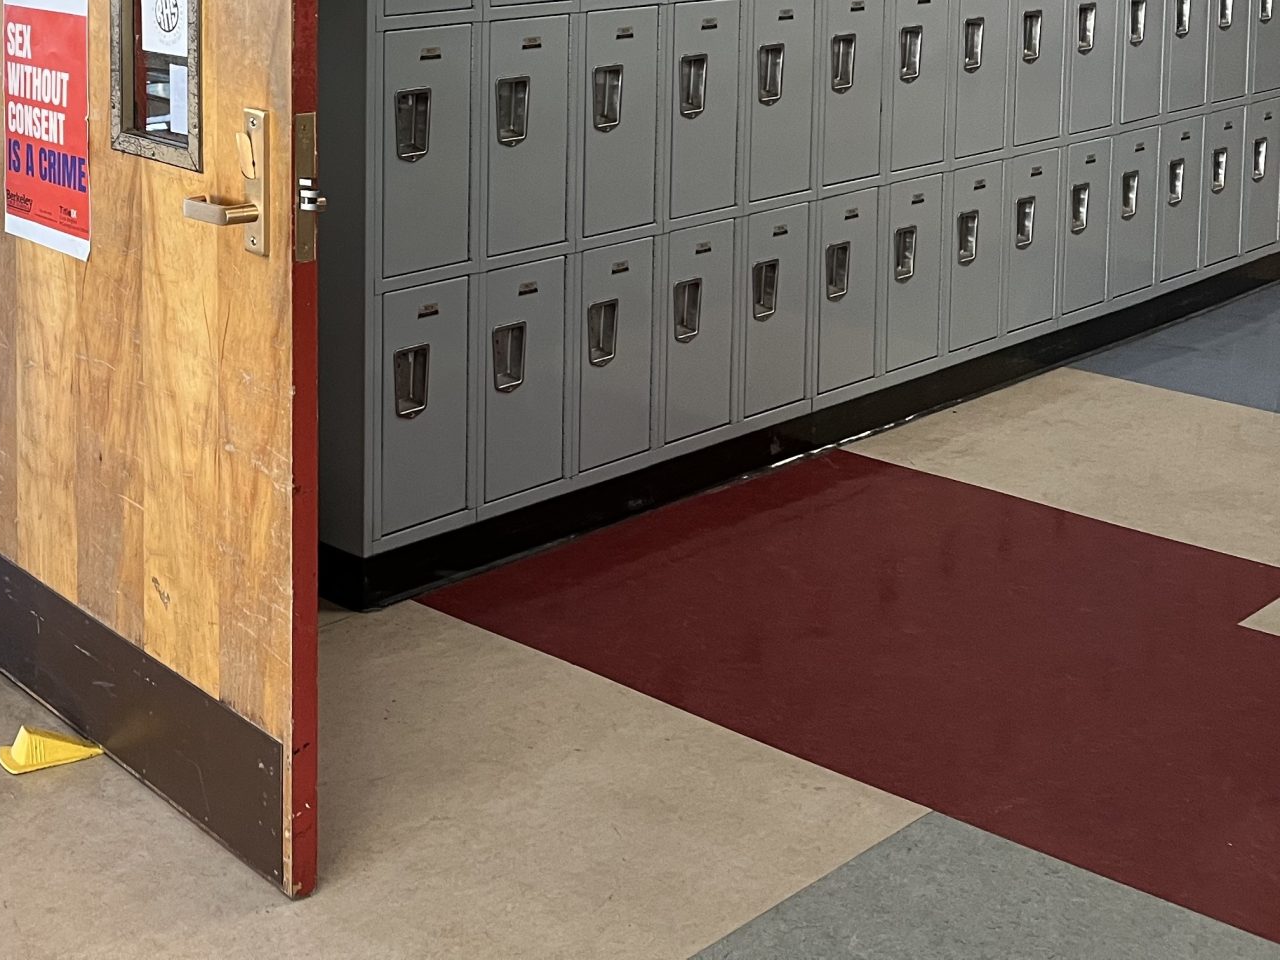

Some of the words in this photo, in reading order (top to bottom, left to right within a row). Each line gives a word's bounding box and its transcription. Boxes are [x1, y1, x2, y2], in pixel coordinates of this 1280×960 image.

[6, 21, 32, 59] SEX
[7, 61, 70, 108] WITHOUT
[7, 100, 66, 146] CONSENT
[8, 138, 21, 174] IS
[26, 143, 35, 177] A
[39, 147, 87, 193] CRIME
[6, 189, 33, 206] Berkeley
